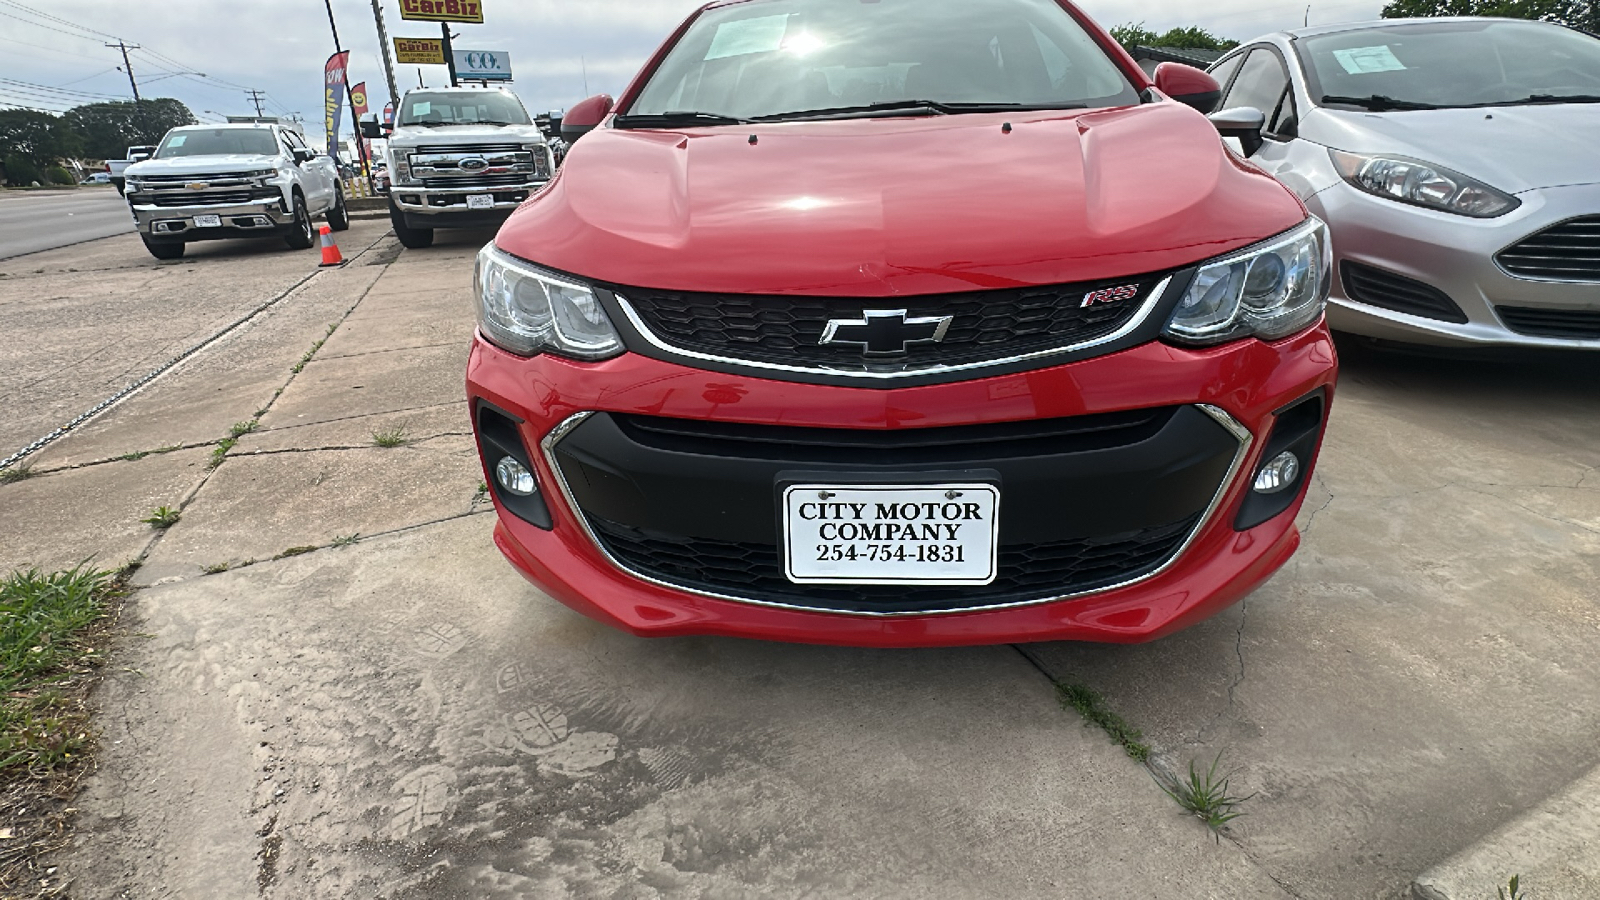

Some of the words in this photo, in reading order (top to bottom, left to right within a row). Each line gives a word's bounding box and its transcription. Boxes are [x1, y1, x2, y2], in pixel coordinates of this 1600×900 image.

[403, 0, 479, 15] CarBiz
[1080, 283, 1140, 308] RS
[798, 502, 867, 520] CITY
[874, 502, 983, 520] MOTOR
[819, 522, 963, 541] COMPANY
[816, 544, 965, 562] 254-754-1831
